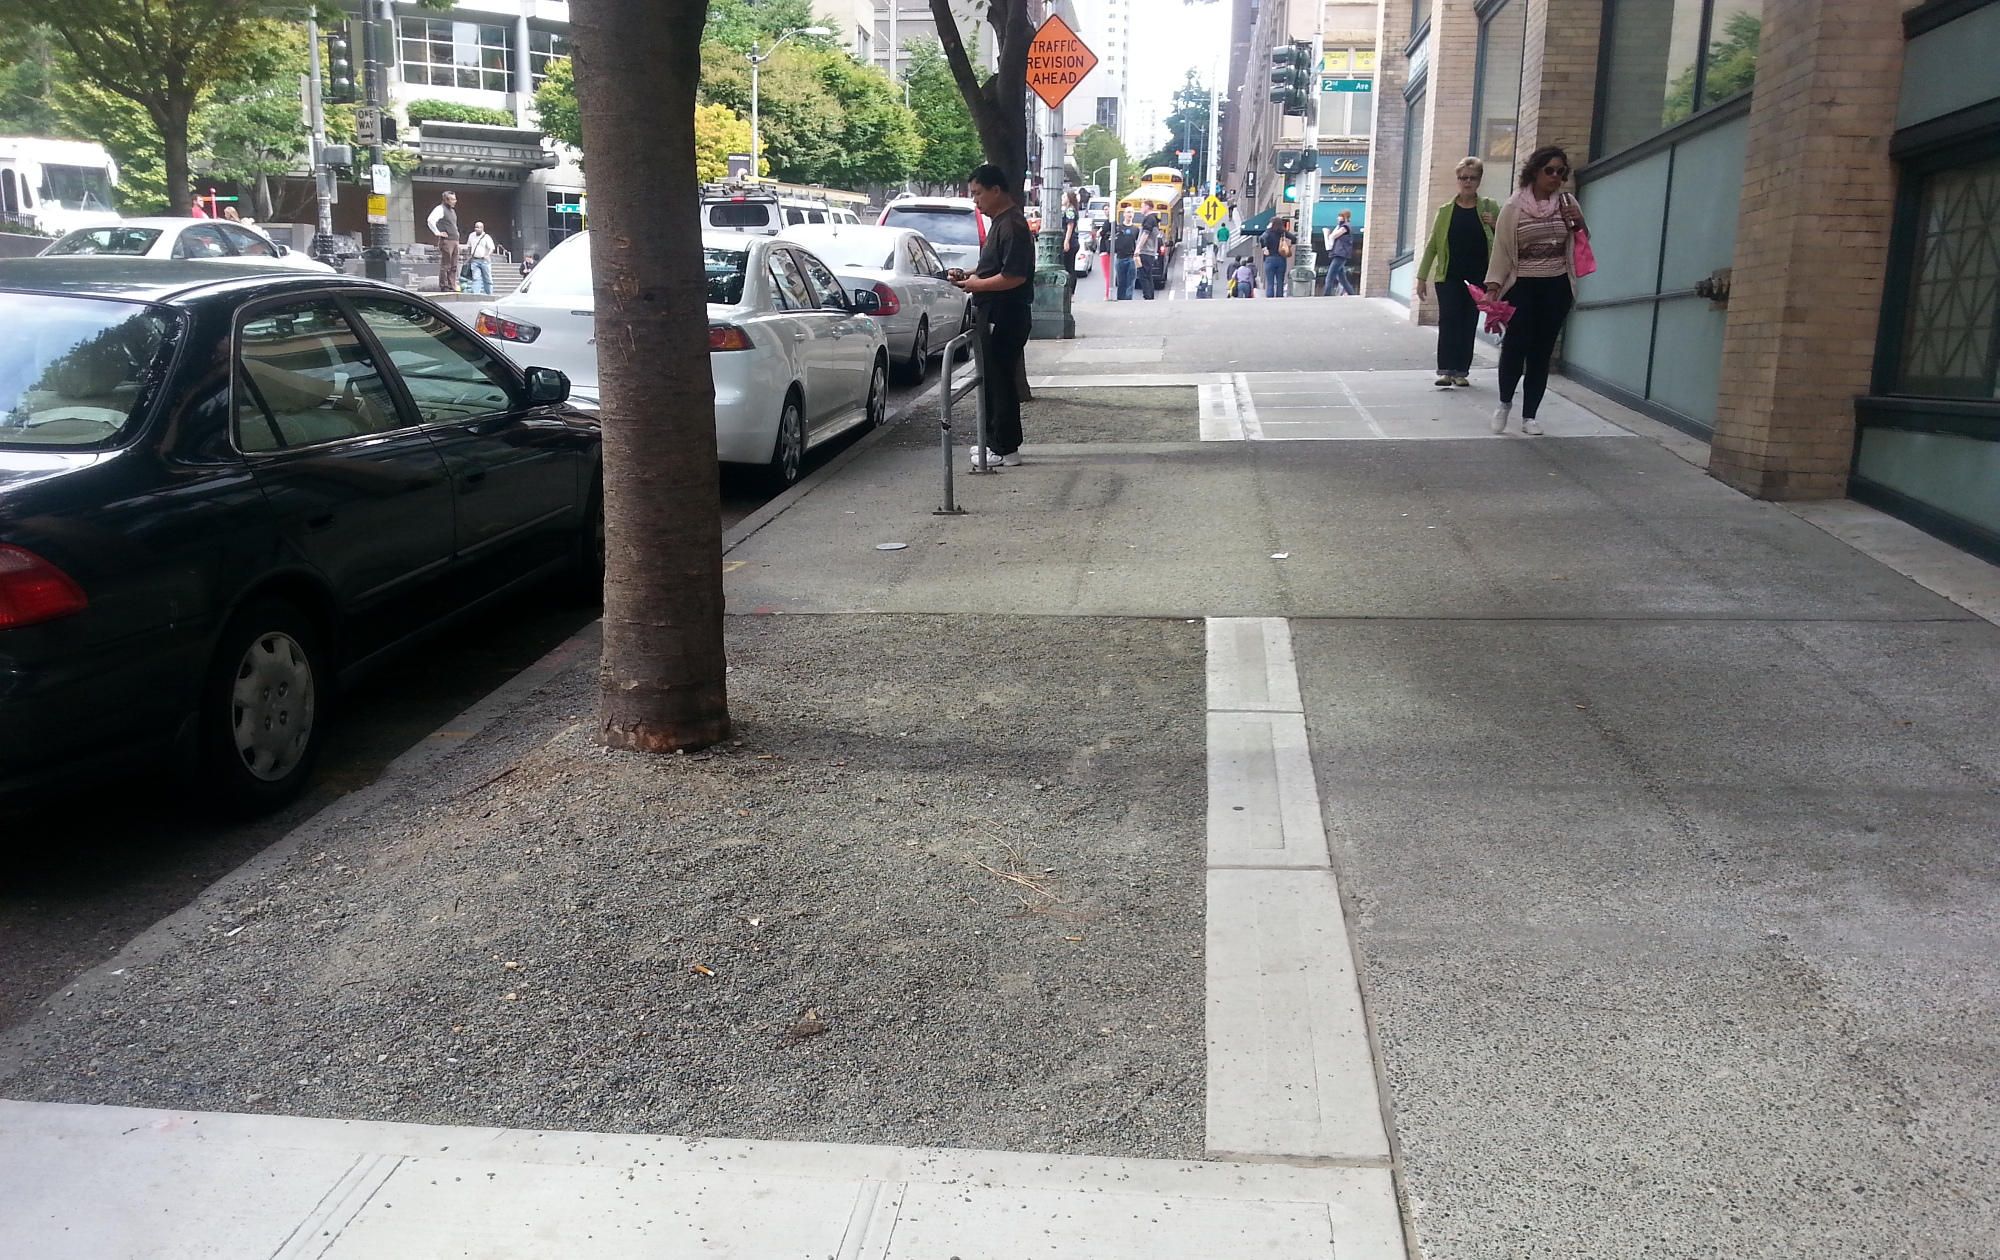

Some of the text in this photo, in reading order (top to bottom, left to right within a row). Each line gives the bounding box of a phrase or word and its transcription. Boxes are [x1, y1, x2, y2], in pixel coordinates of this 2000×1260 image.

[1032, 40, 1078, 53] TRAFFIC
[1027, 55, 1084, 69] REVISION
[1032, 72, 1077, 85] AHEAD
[1324, 80, 1369, 91] 2nd Ave
[357, 109, 374, 119] ONE
[358, 120, 375, 131] WAY
[508, 147, 544, 160] HALL
[1330, 157, 1364, 173] The
[410, 166, 522, 181] METRO TUNNEL
[1327, 184, 1358, 195] Seafood
